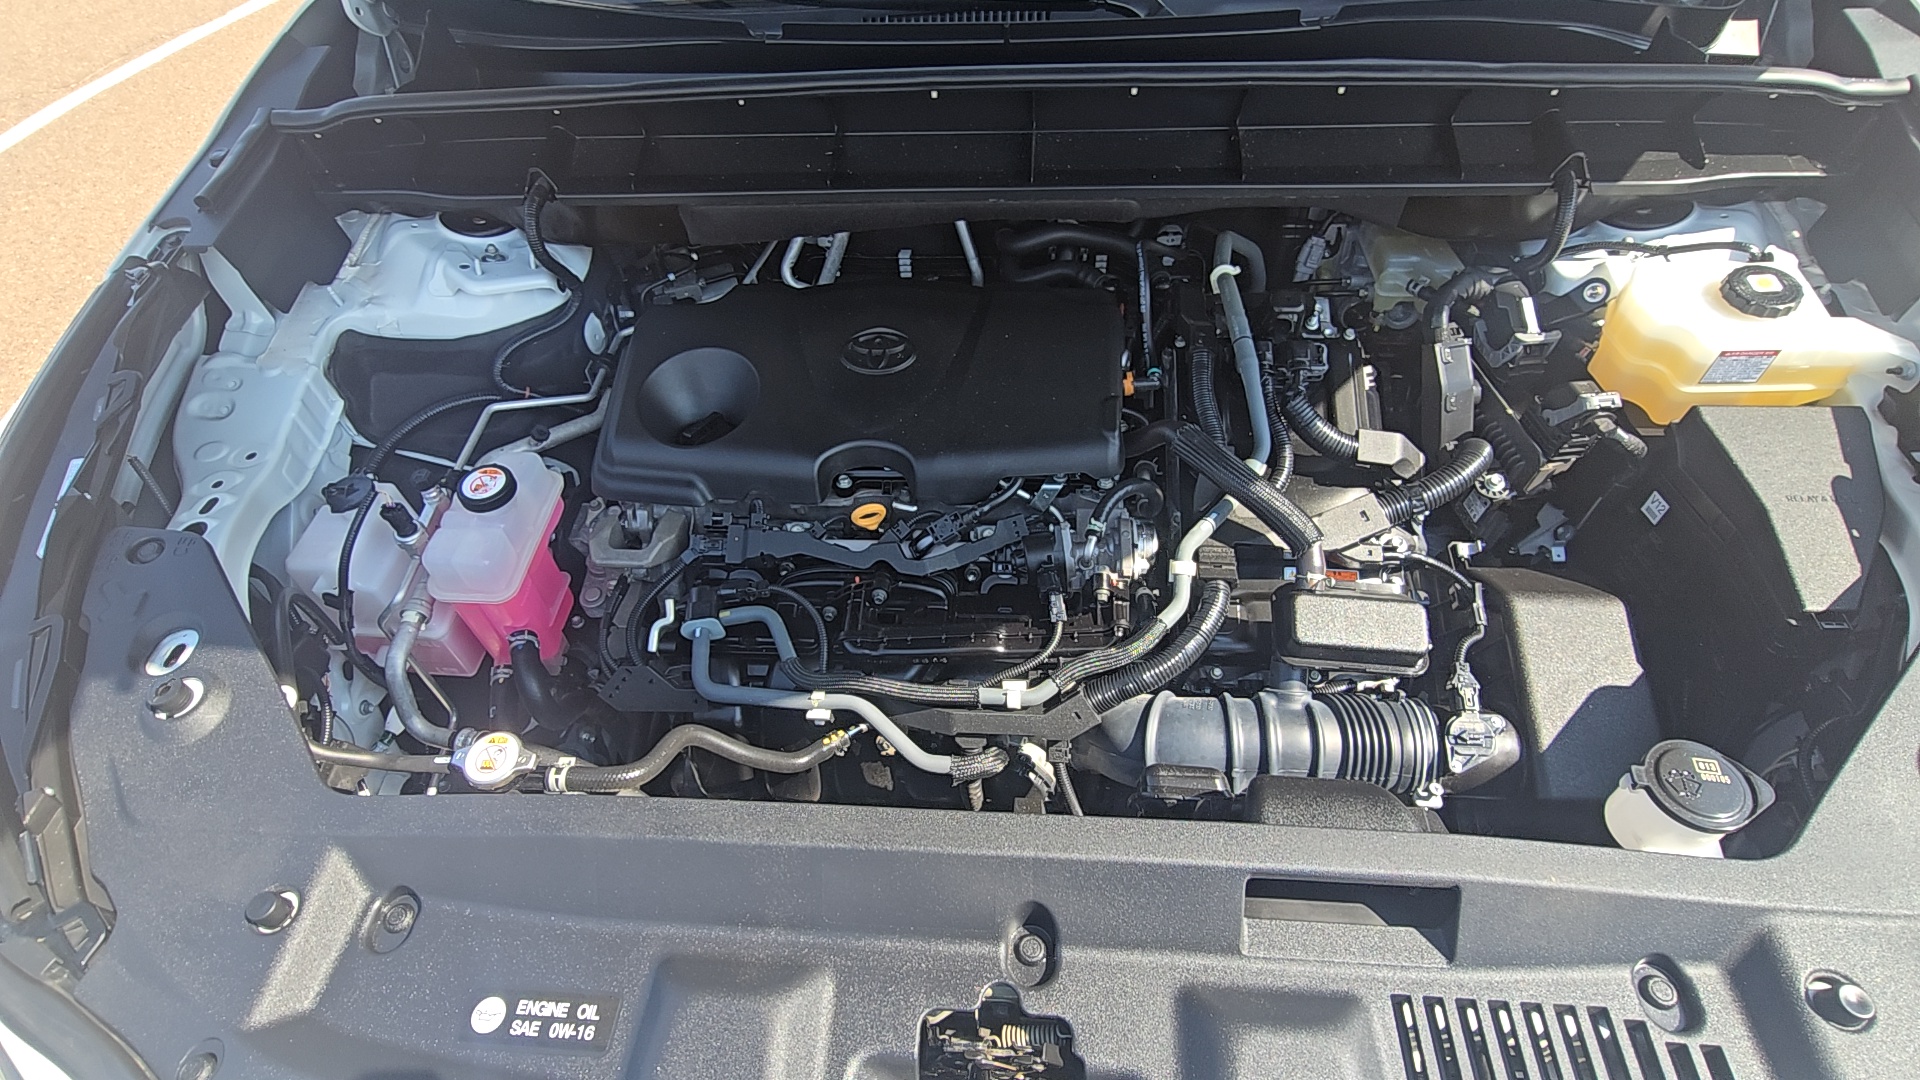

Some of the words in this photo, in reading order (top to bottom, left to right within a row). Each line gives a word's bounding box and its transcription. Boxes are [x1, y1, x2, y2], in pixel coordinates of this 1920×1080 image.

[1651, 494, 1666, 515] V12
[515, 999, 570, 1018] ENGINE
[576, 1003, 600, 1021] OIL
[509, 1019, 542, 1037] SAE
[548, 1022, 596, 1041] 0W-16
